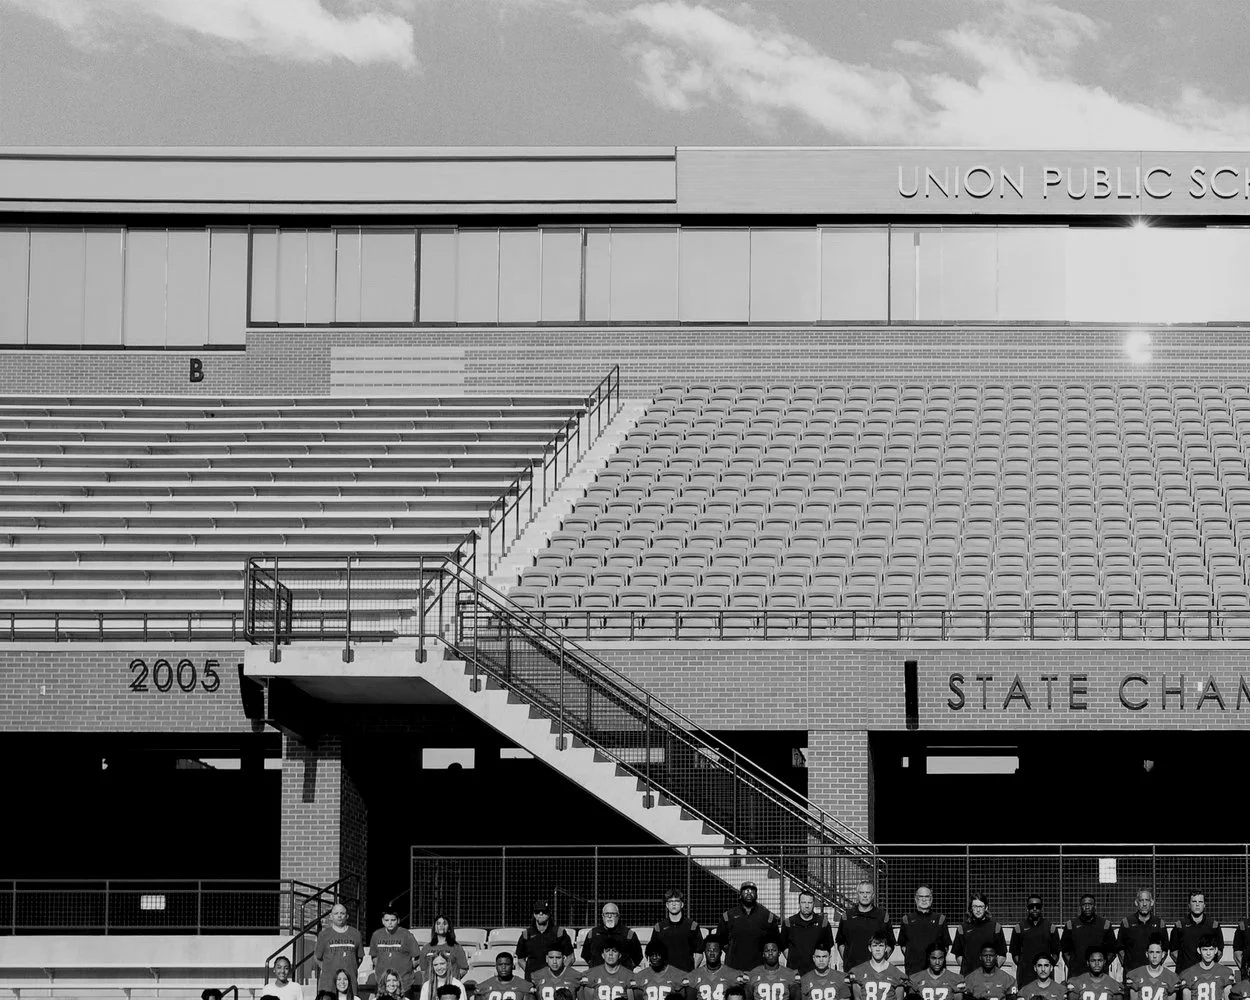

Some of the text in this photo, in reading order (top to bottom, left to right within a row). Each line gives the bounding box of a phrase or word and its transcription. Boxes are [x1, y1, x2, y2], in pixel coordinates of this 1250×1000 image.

[898, 165, 1024, 199] UNION
[1043, 166, 1173, 200] PUBLIC
[190, 358, 204, 382] B
[129, 659, 220, 693] 2005
[947, 673, 1088, 711] STATE
